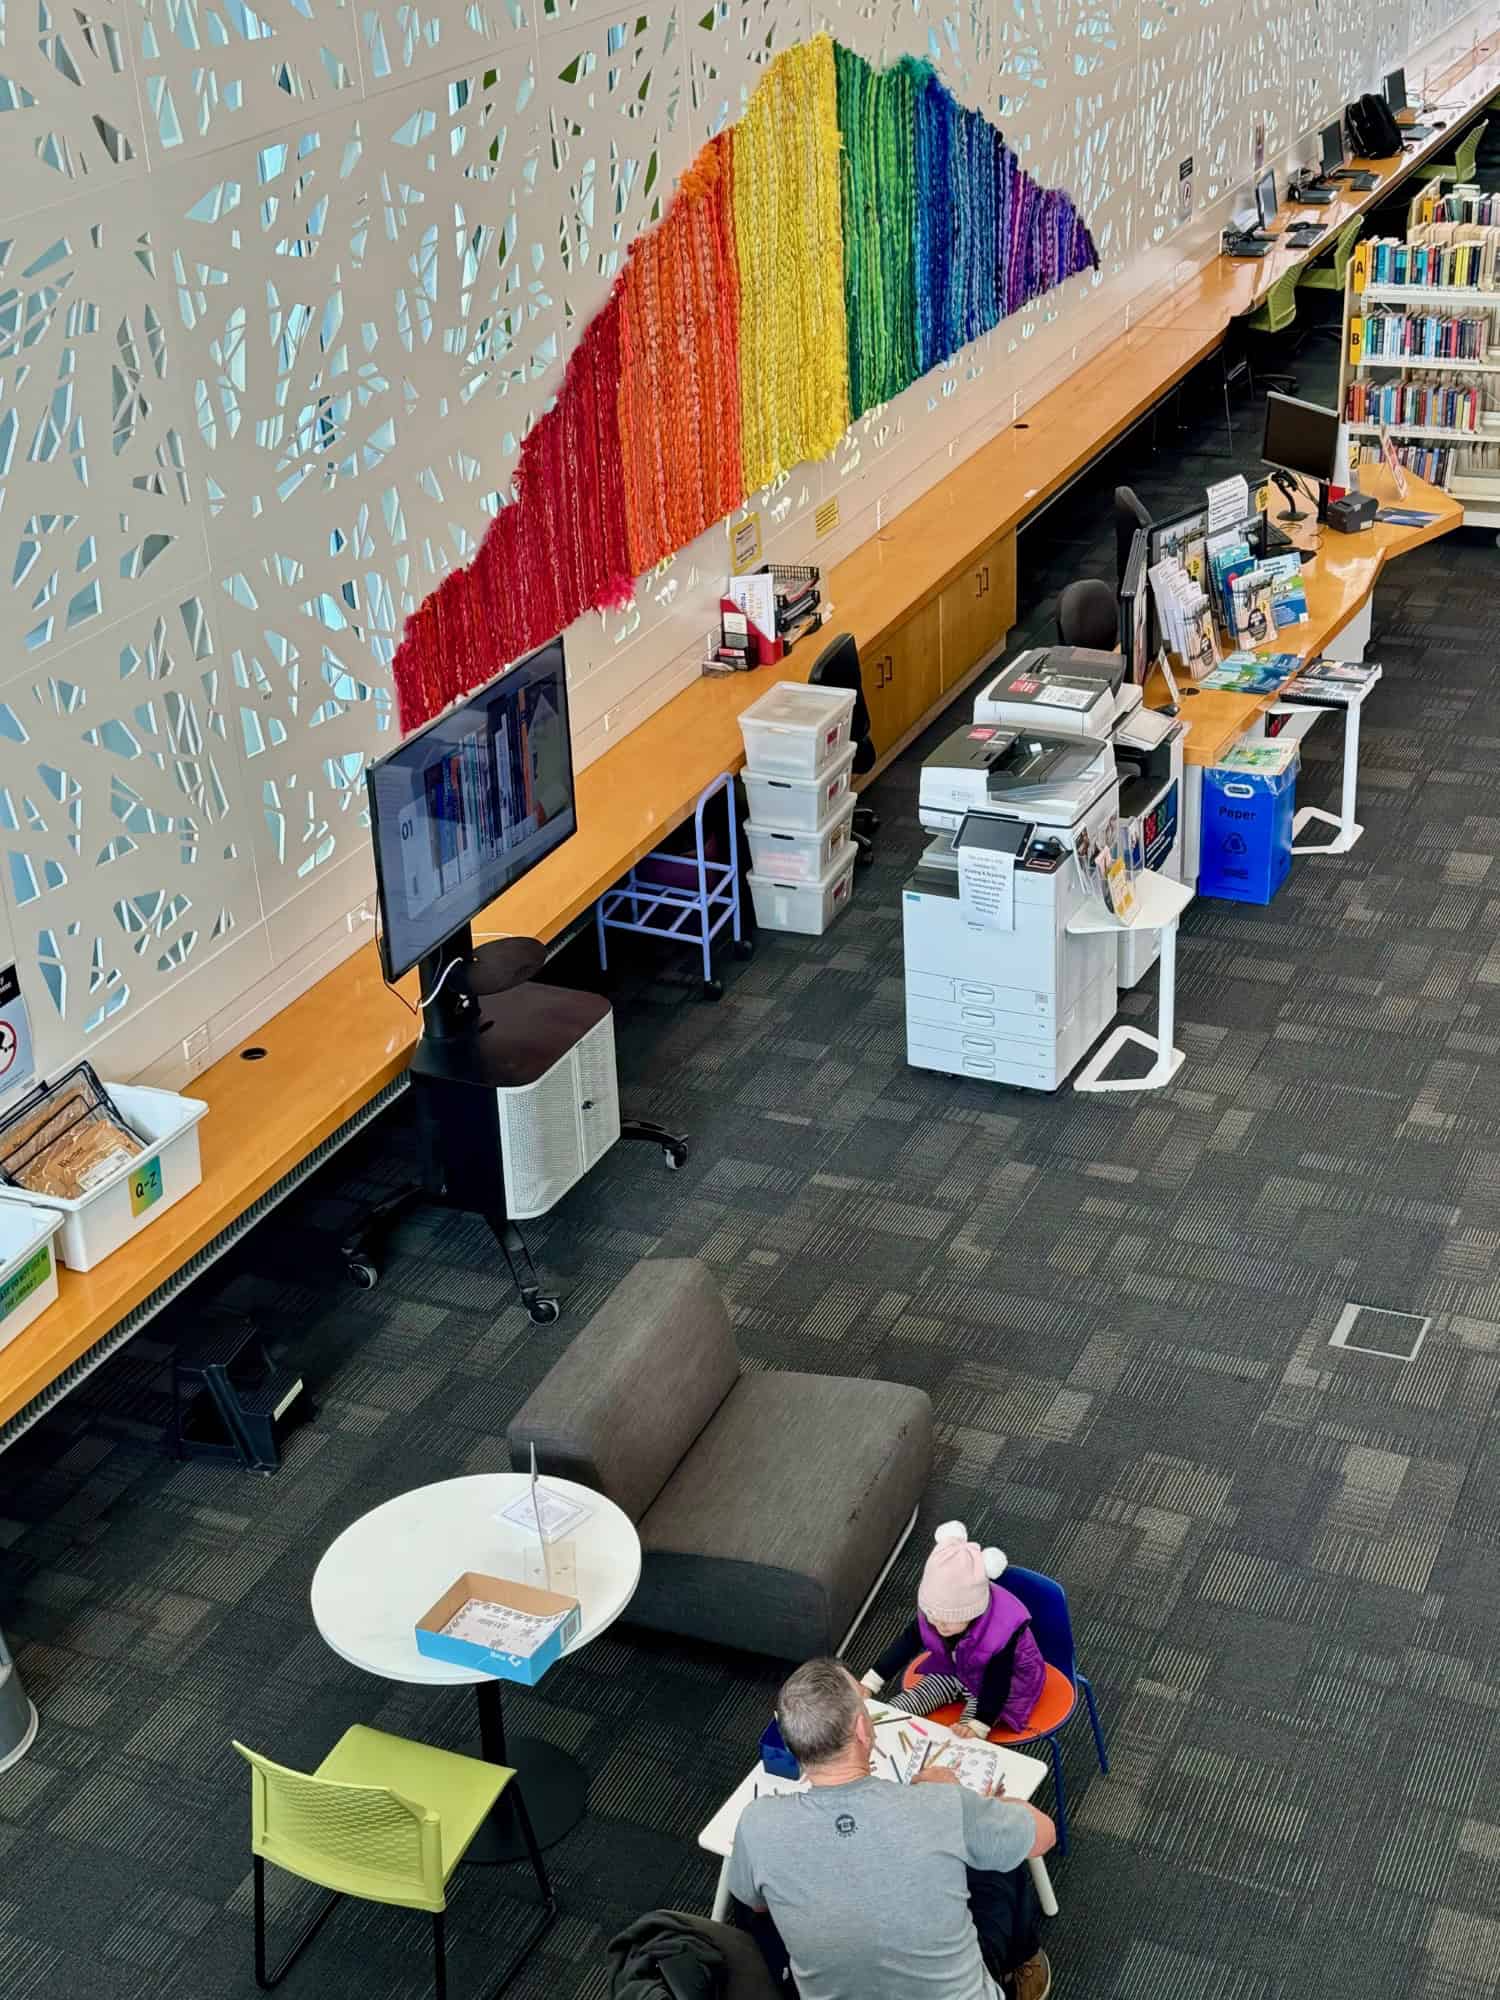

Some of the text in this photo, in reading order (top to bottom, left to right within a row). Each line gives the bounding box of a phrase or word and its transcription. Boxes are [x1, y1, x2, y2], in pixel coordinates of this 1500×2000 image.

[1355, 260, 1364, 273] A
[1352, 332, 1360, 345] B
[1217, 805, 1257, 821] Paper
[401, 819, 414, 841] 01
[135, 1171, 158, 1198] Q-Z
